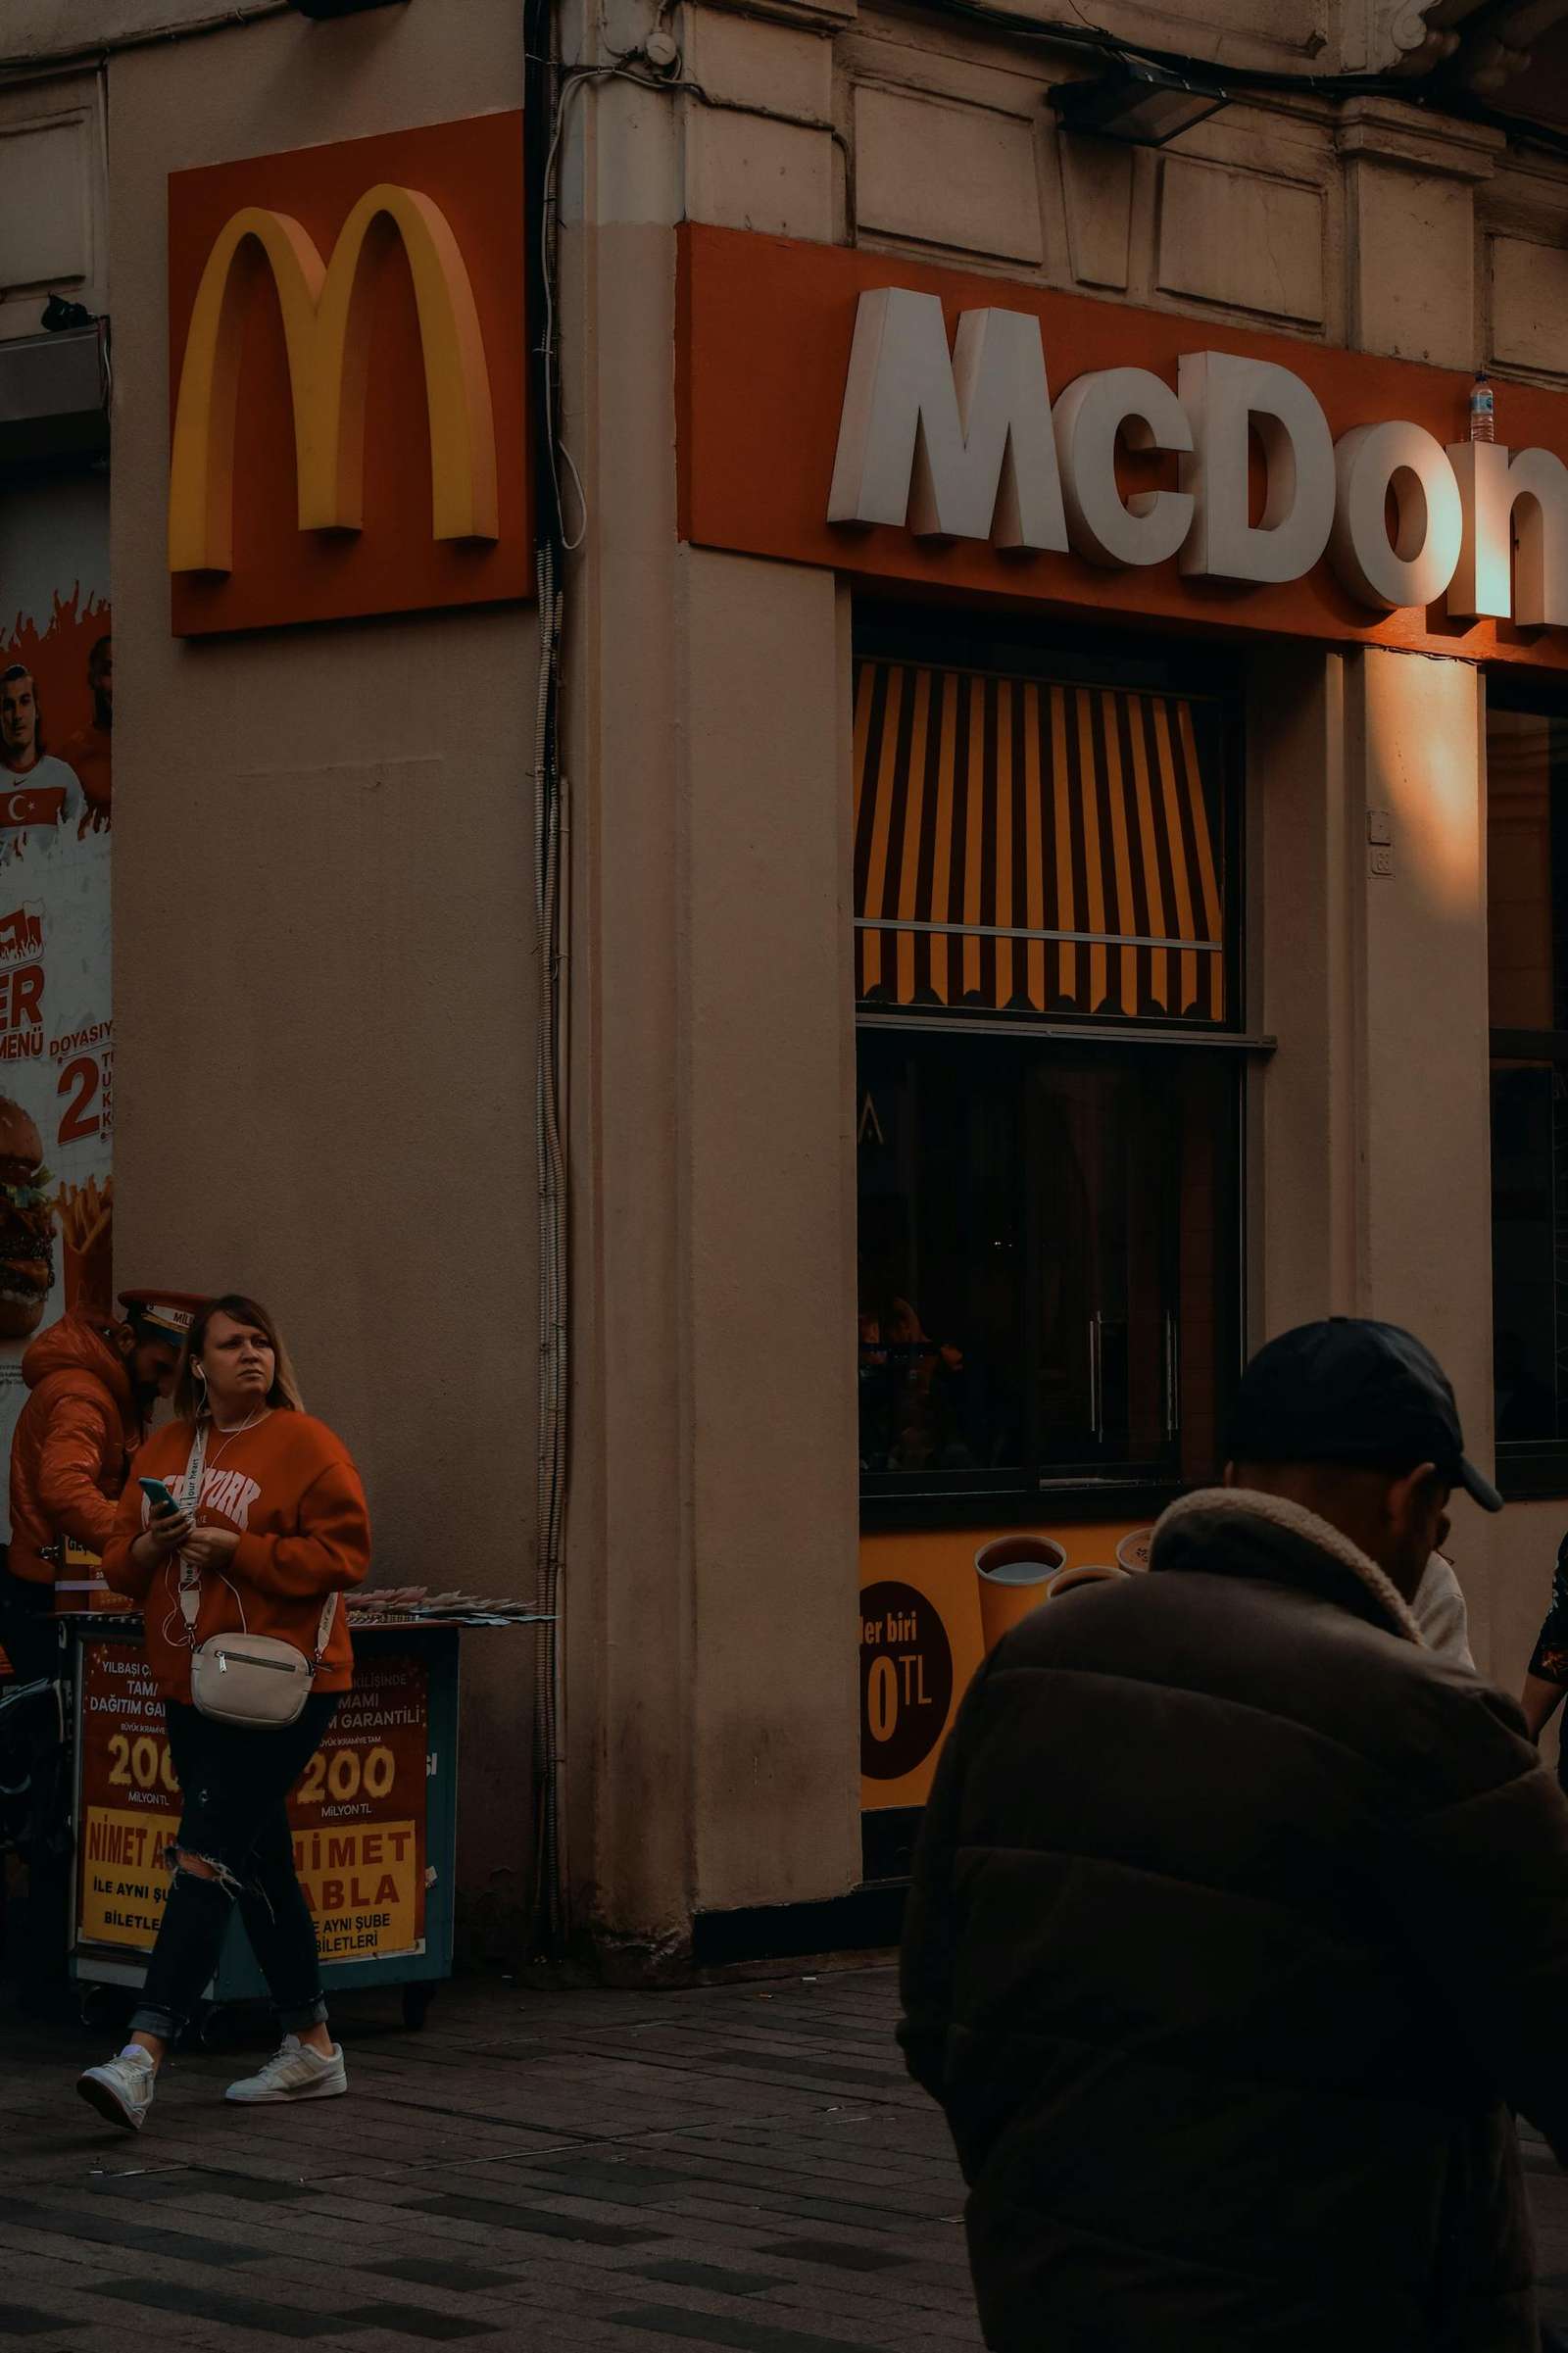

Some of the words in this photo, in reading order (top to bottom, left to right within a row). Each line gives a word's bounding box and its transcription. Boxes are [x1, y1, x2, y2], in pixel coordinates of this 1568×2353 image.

[886, 1610, 917, 1643] biri
[102, 1661, 140, 1678] YILBAŞI
[90, 1693, 141, 1715] DAĞITIM
[340, 1703, 420, 1729] GARANTİLİ
[296, 1744, 396, 1804] 200
[127, 1790, 159, 1805] MİLYON
[321, 1803, 360, 1818] MİLYON
[88, 1813, 148, 1867] NİMET
[93, 1874, 114, 1893] İLE
[117, 1882, 149, 1899] AYNI
[323, 1918, 352, 1933] AYNI
[355, 1912, 391, 1934] ŞUBE
